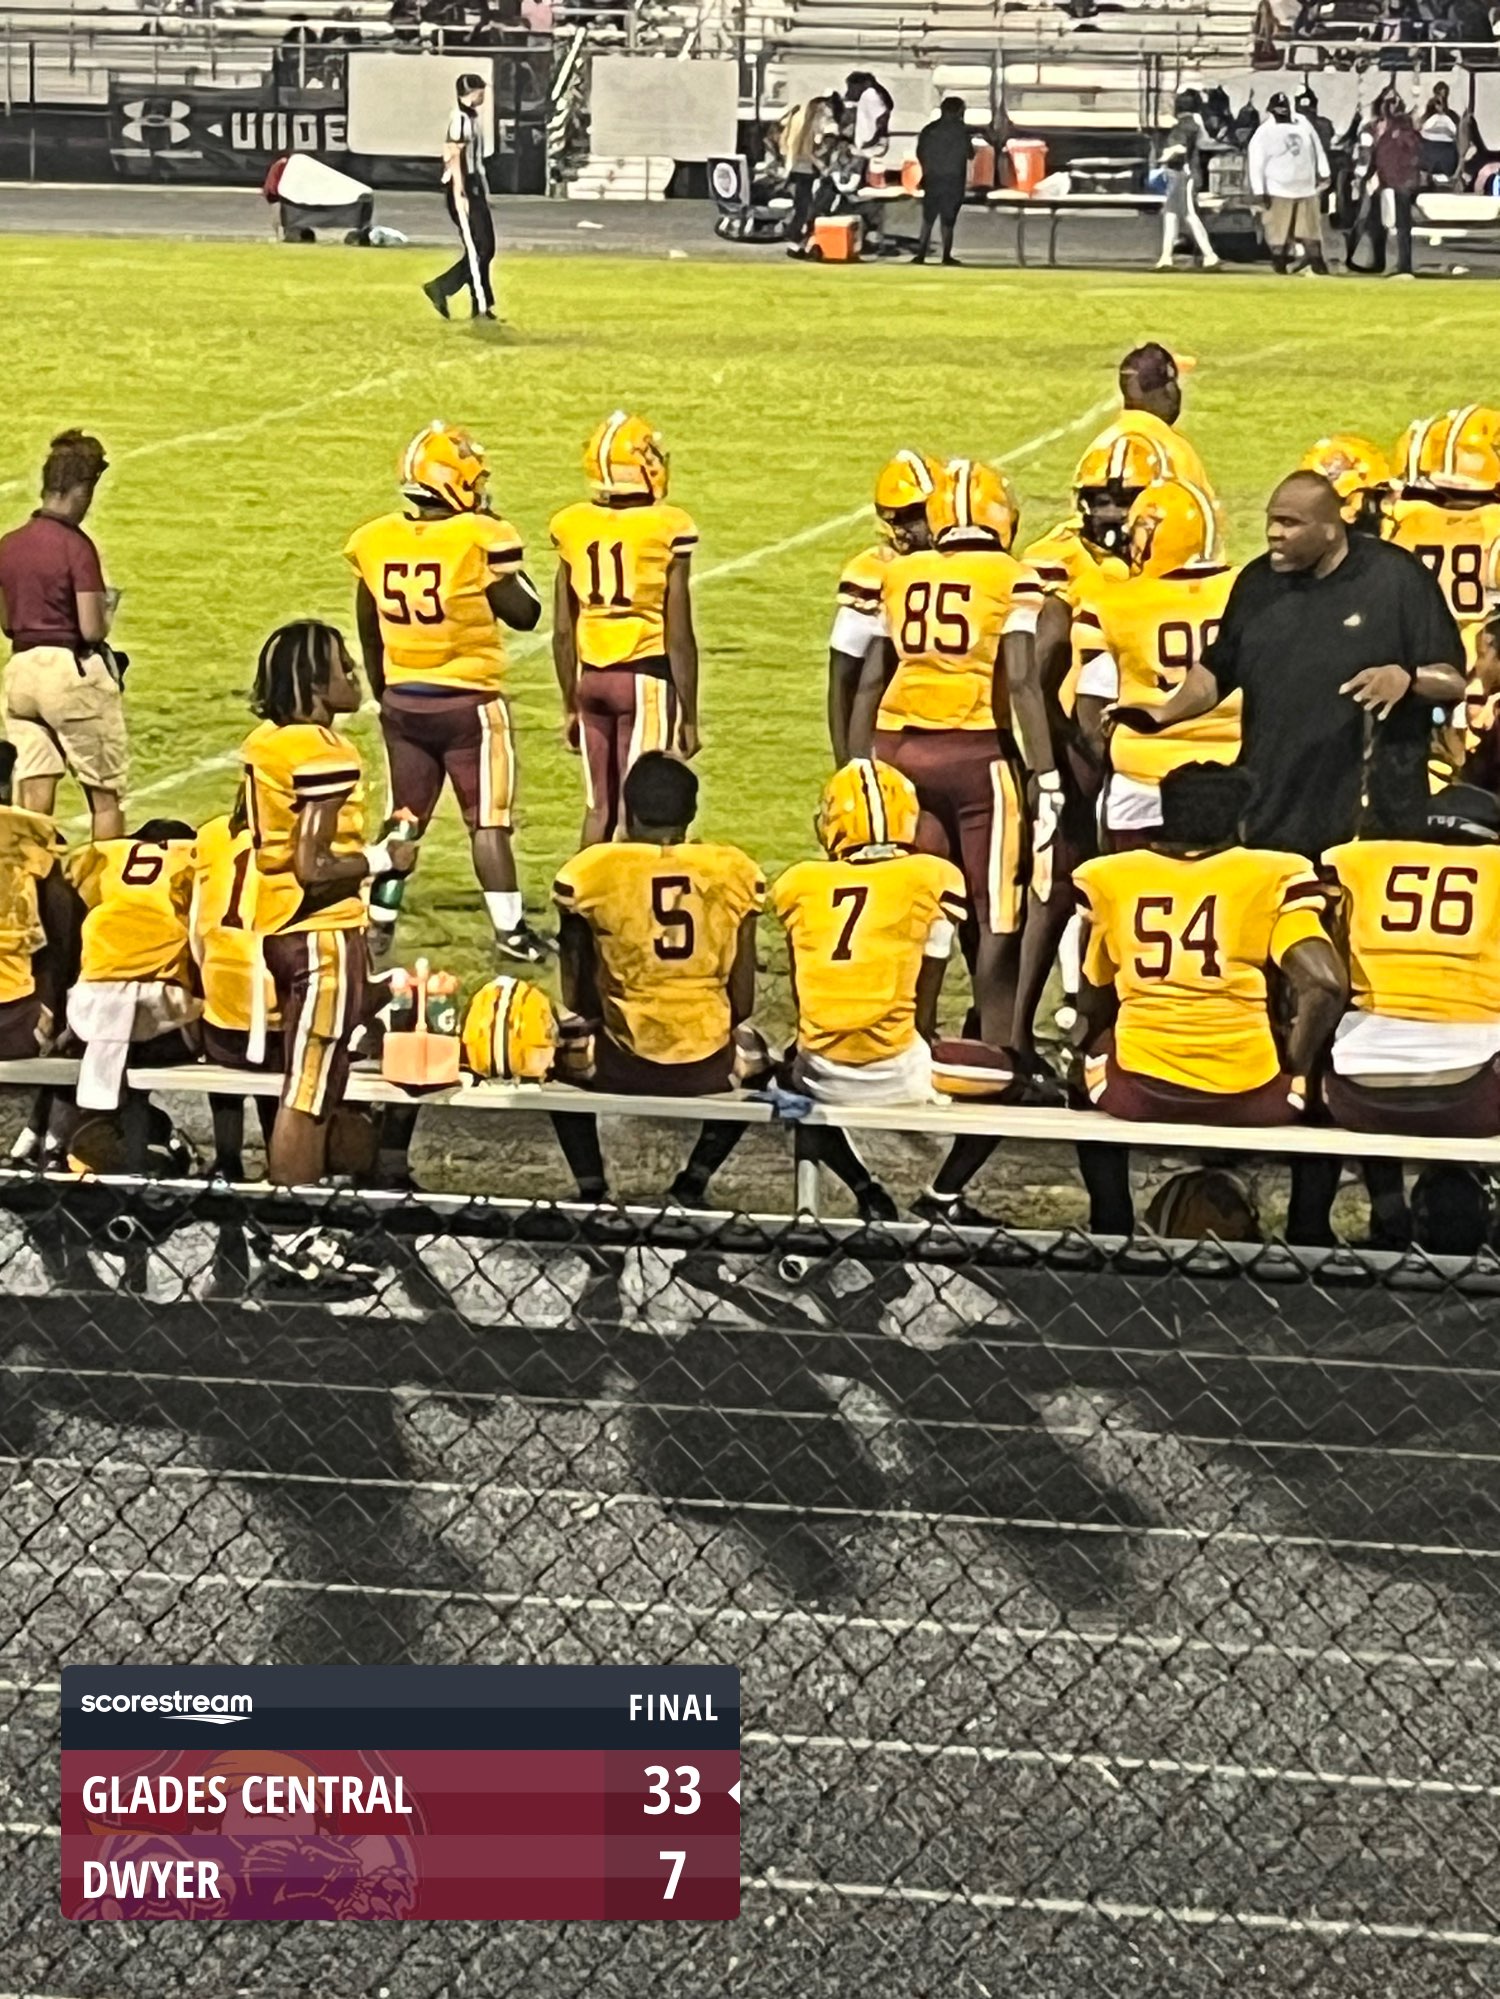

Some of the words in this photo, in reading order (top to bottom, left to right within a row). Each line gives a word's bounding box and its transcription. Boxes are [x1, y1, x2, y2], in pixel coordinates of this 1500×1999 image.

[231, 112, 347, 151] UNDE
[381, 563, 445, 625] 53
[587, 540, 632, 606] 11
[901, 582, 971, 655] 85
[122, 840, 168, 885] 6
[221, 847, 252, 929] 1
[652, 876, 694, 960] 5
[831, 886, 869, 961] 7
[1381, 866, 1478, 935] 56
[1134, 895, 1221, 978] 54
